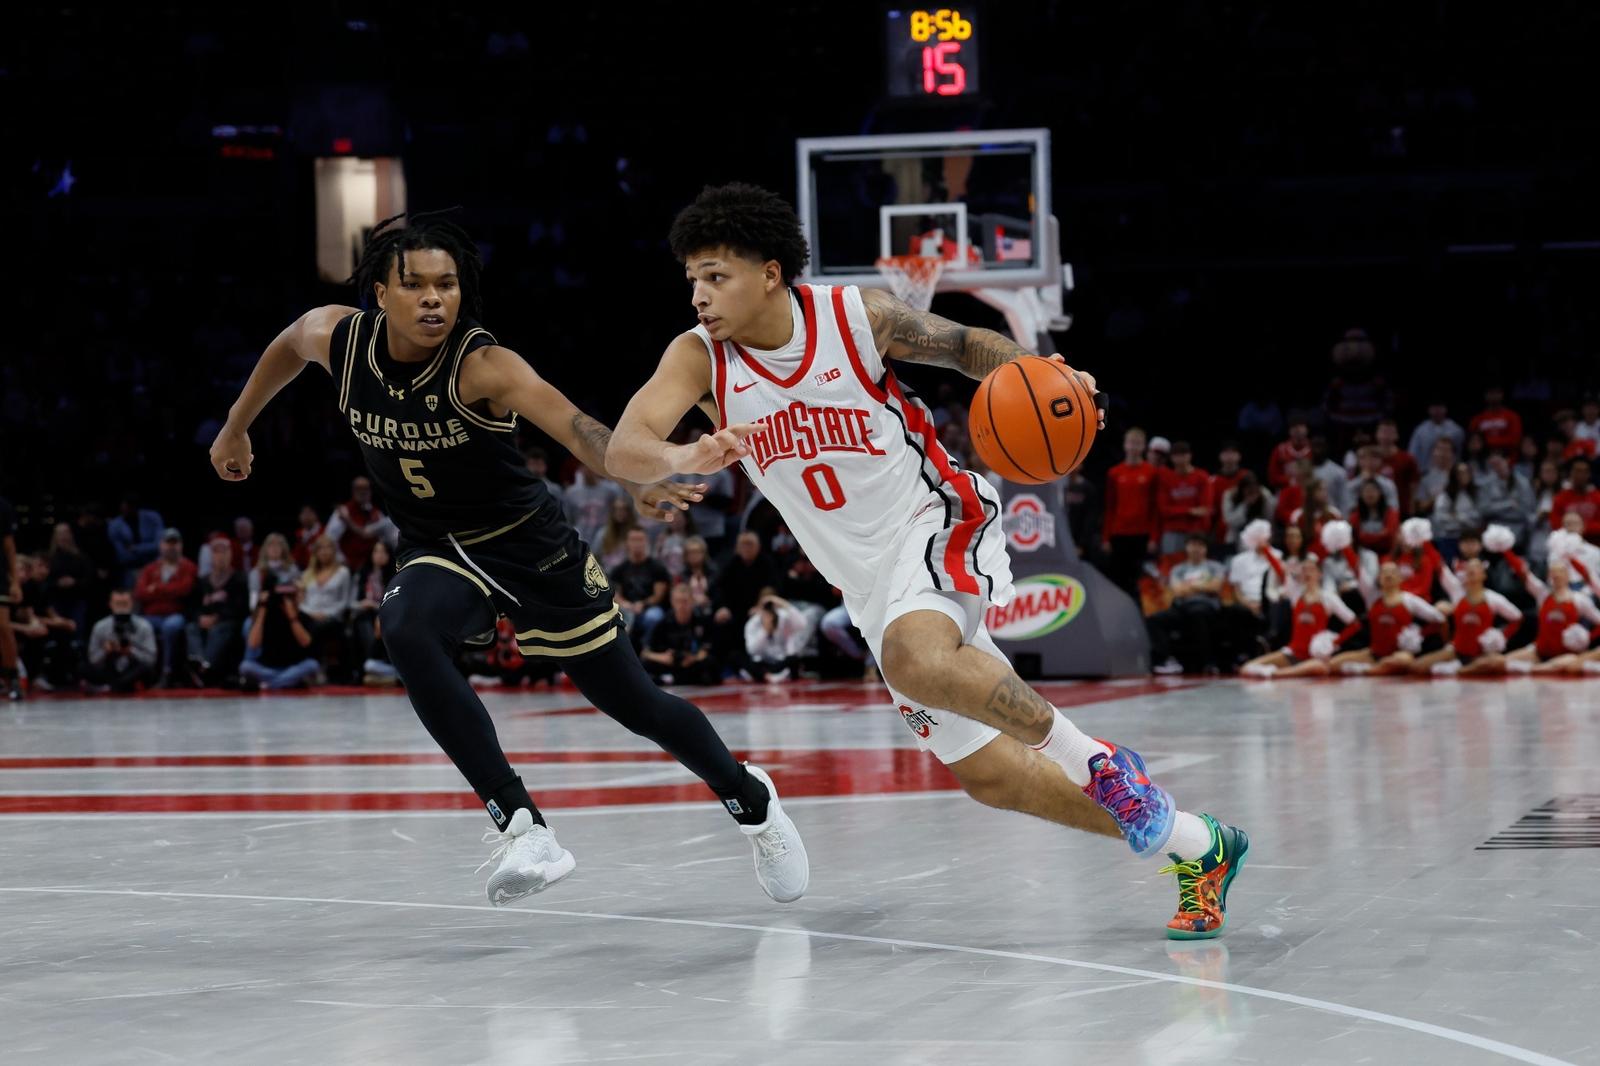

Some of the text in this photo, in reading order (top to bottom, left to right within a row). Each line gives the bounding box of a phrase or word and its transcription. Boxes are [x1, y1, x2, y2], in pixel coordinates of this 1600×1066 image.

[910, 9, 972, 42] 8:56
[923, 41, 966, 96] 15
[350, 407, 464, 439] PURDUE
[398, 431, 470, 452] WAYNE
[788, 400, 887, 460] STATE
[399, 457, 435, 499] 5
[801, 462, 847, 512] 0
[984, 584, 1073, 631] IBMAN
